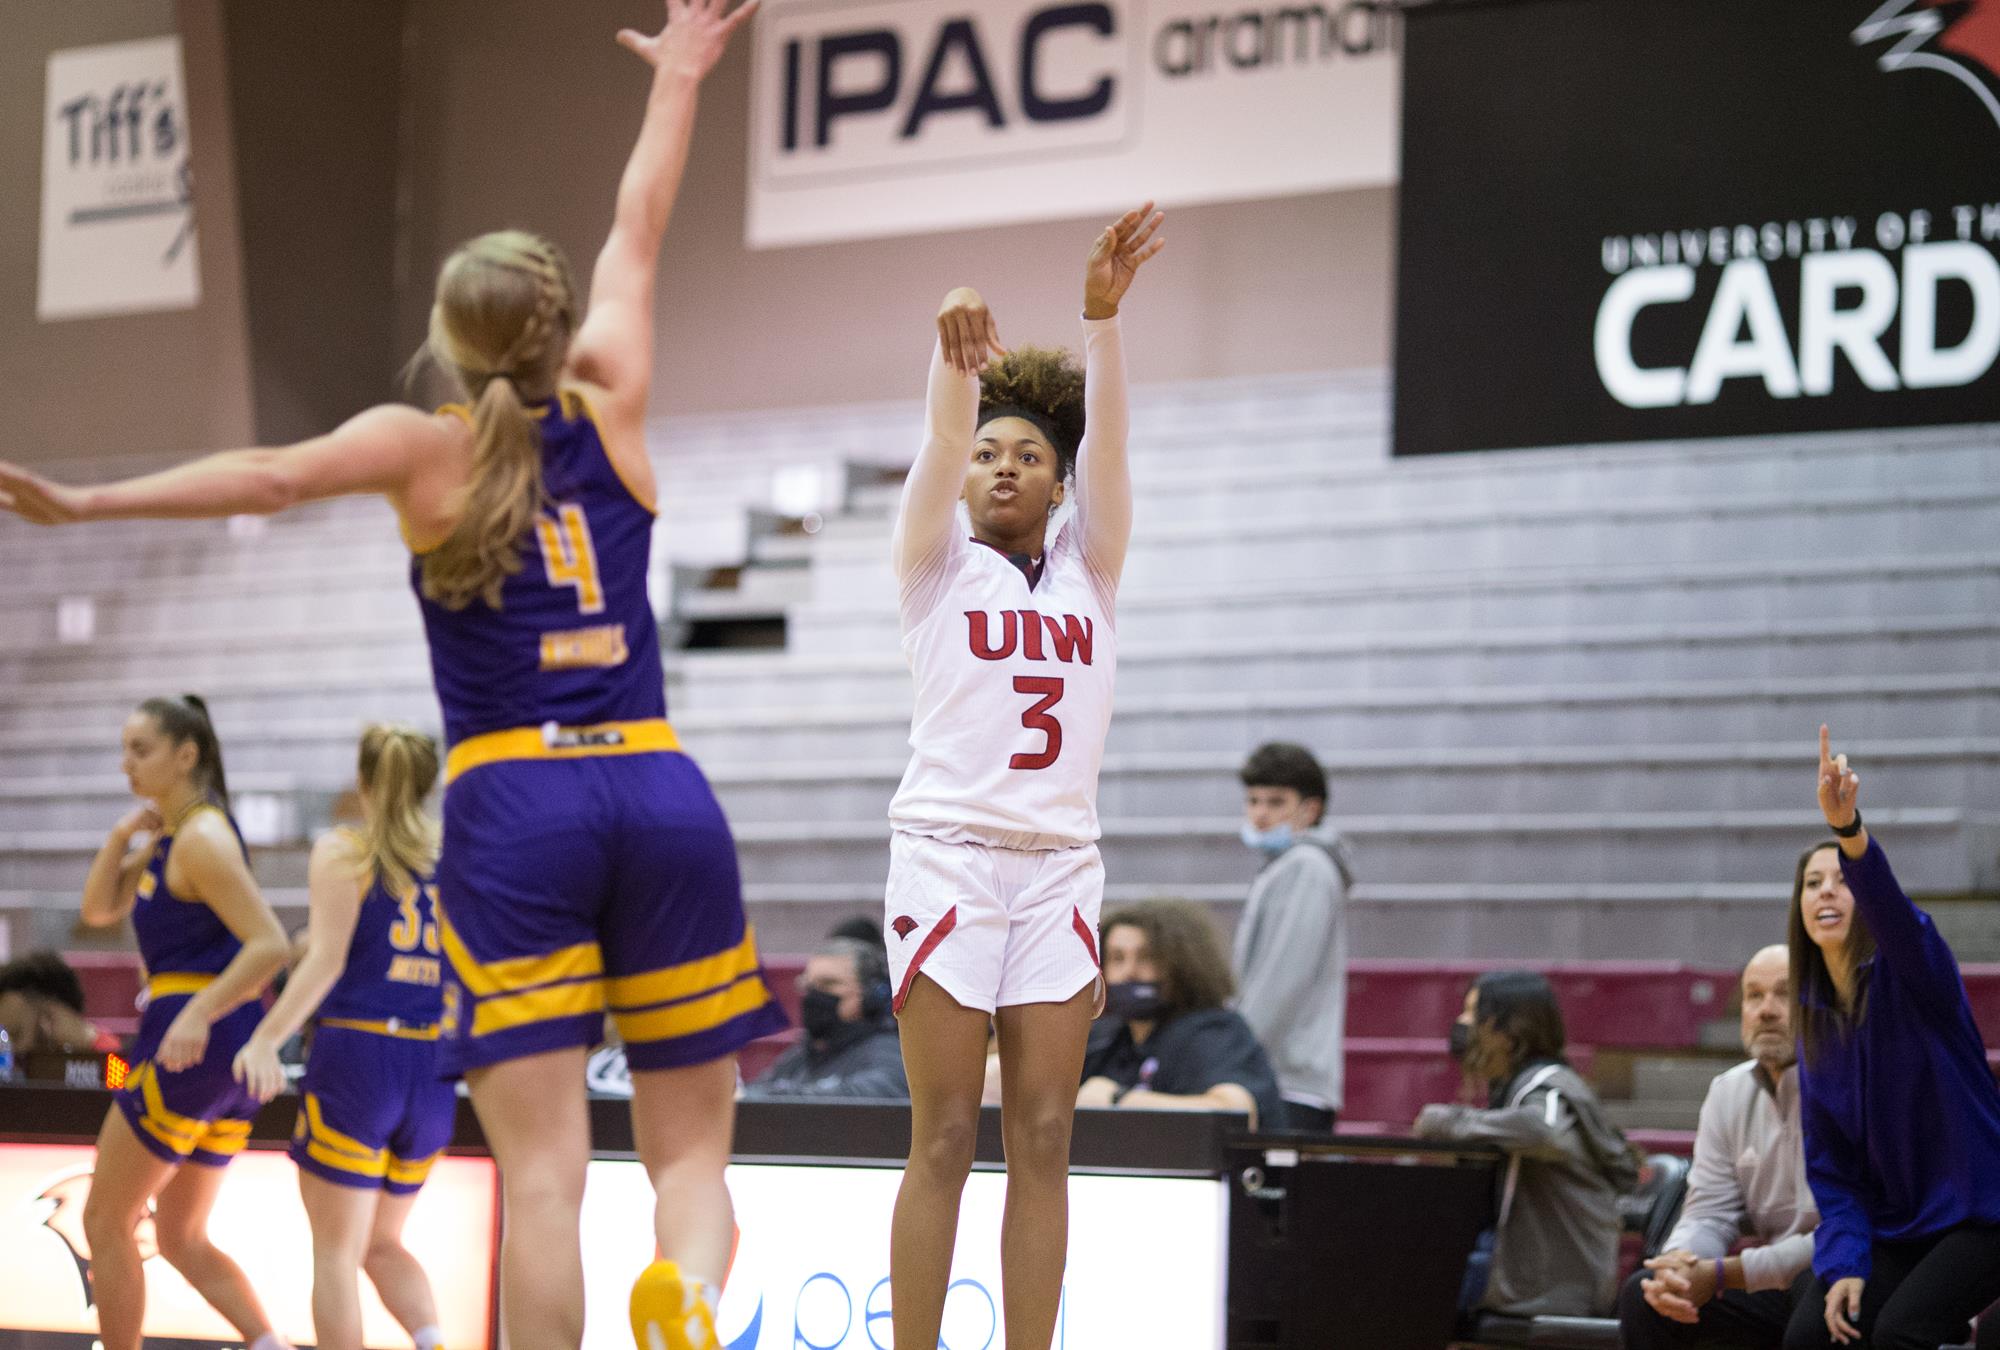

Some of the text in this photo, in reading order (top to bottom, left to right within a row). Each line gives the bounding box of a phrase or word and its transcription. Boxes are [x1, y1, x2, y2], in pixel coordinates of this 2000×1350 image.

[780, 1, 1116, 152] IPAC
[1601, 215, 1857, 274] UNIVERSITY
[1875, 208, 1932, 251] OF
[1593, 240, 2000, 409] CARD
[536, 502, 605, 615] 4
[963, 609, 1094, 666] UIW
[1008, 675, 1064, 770] 3
